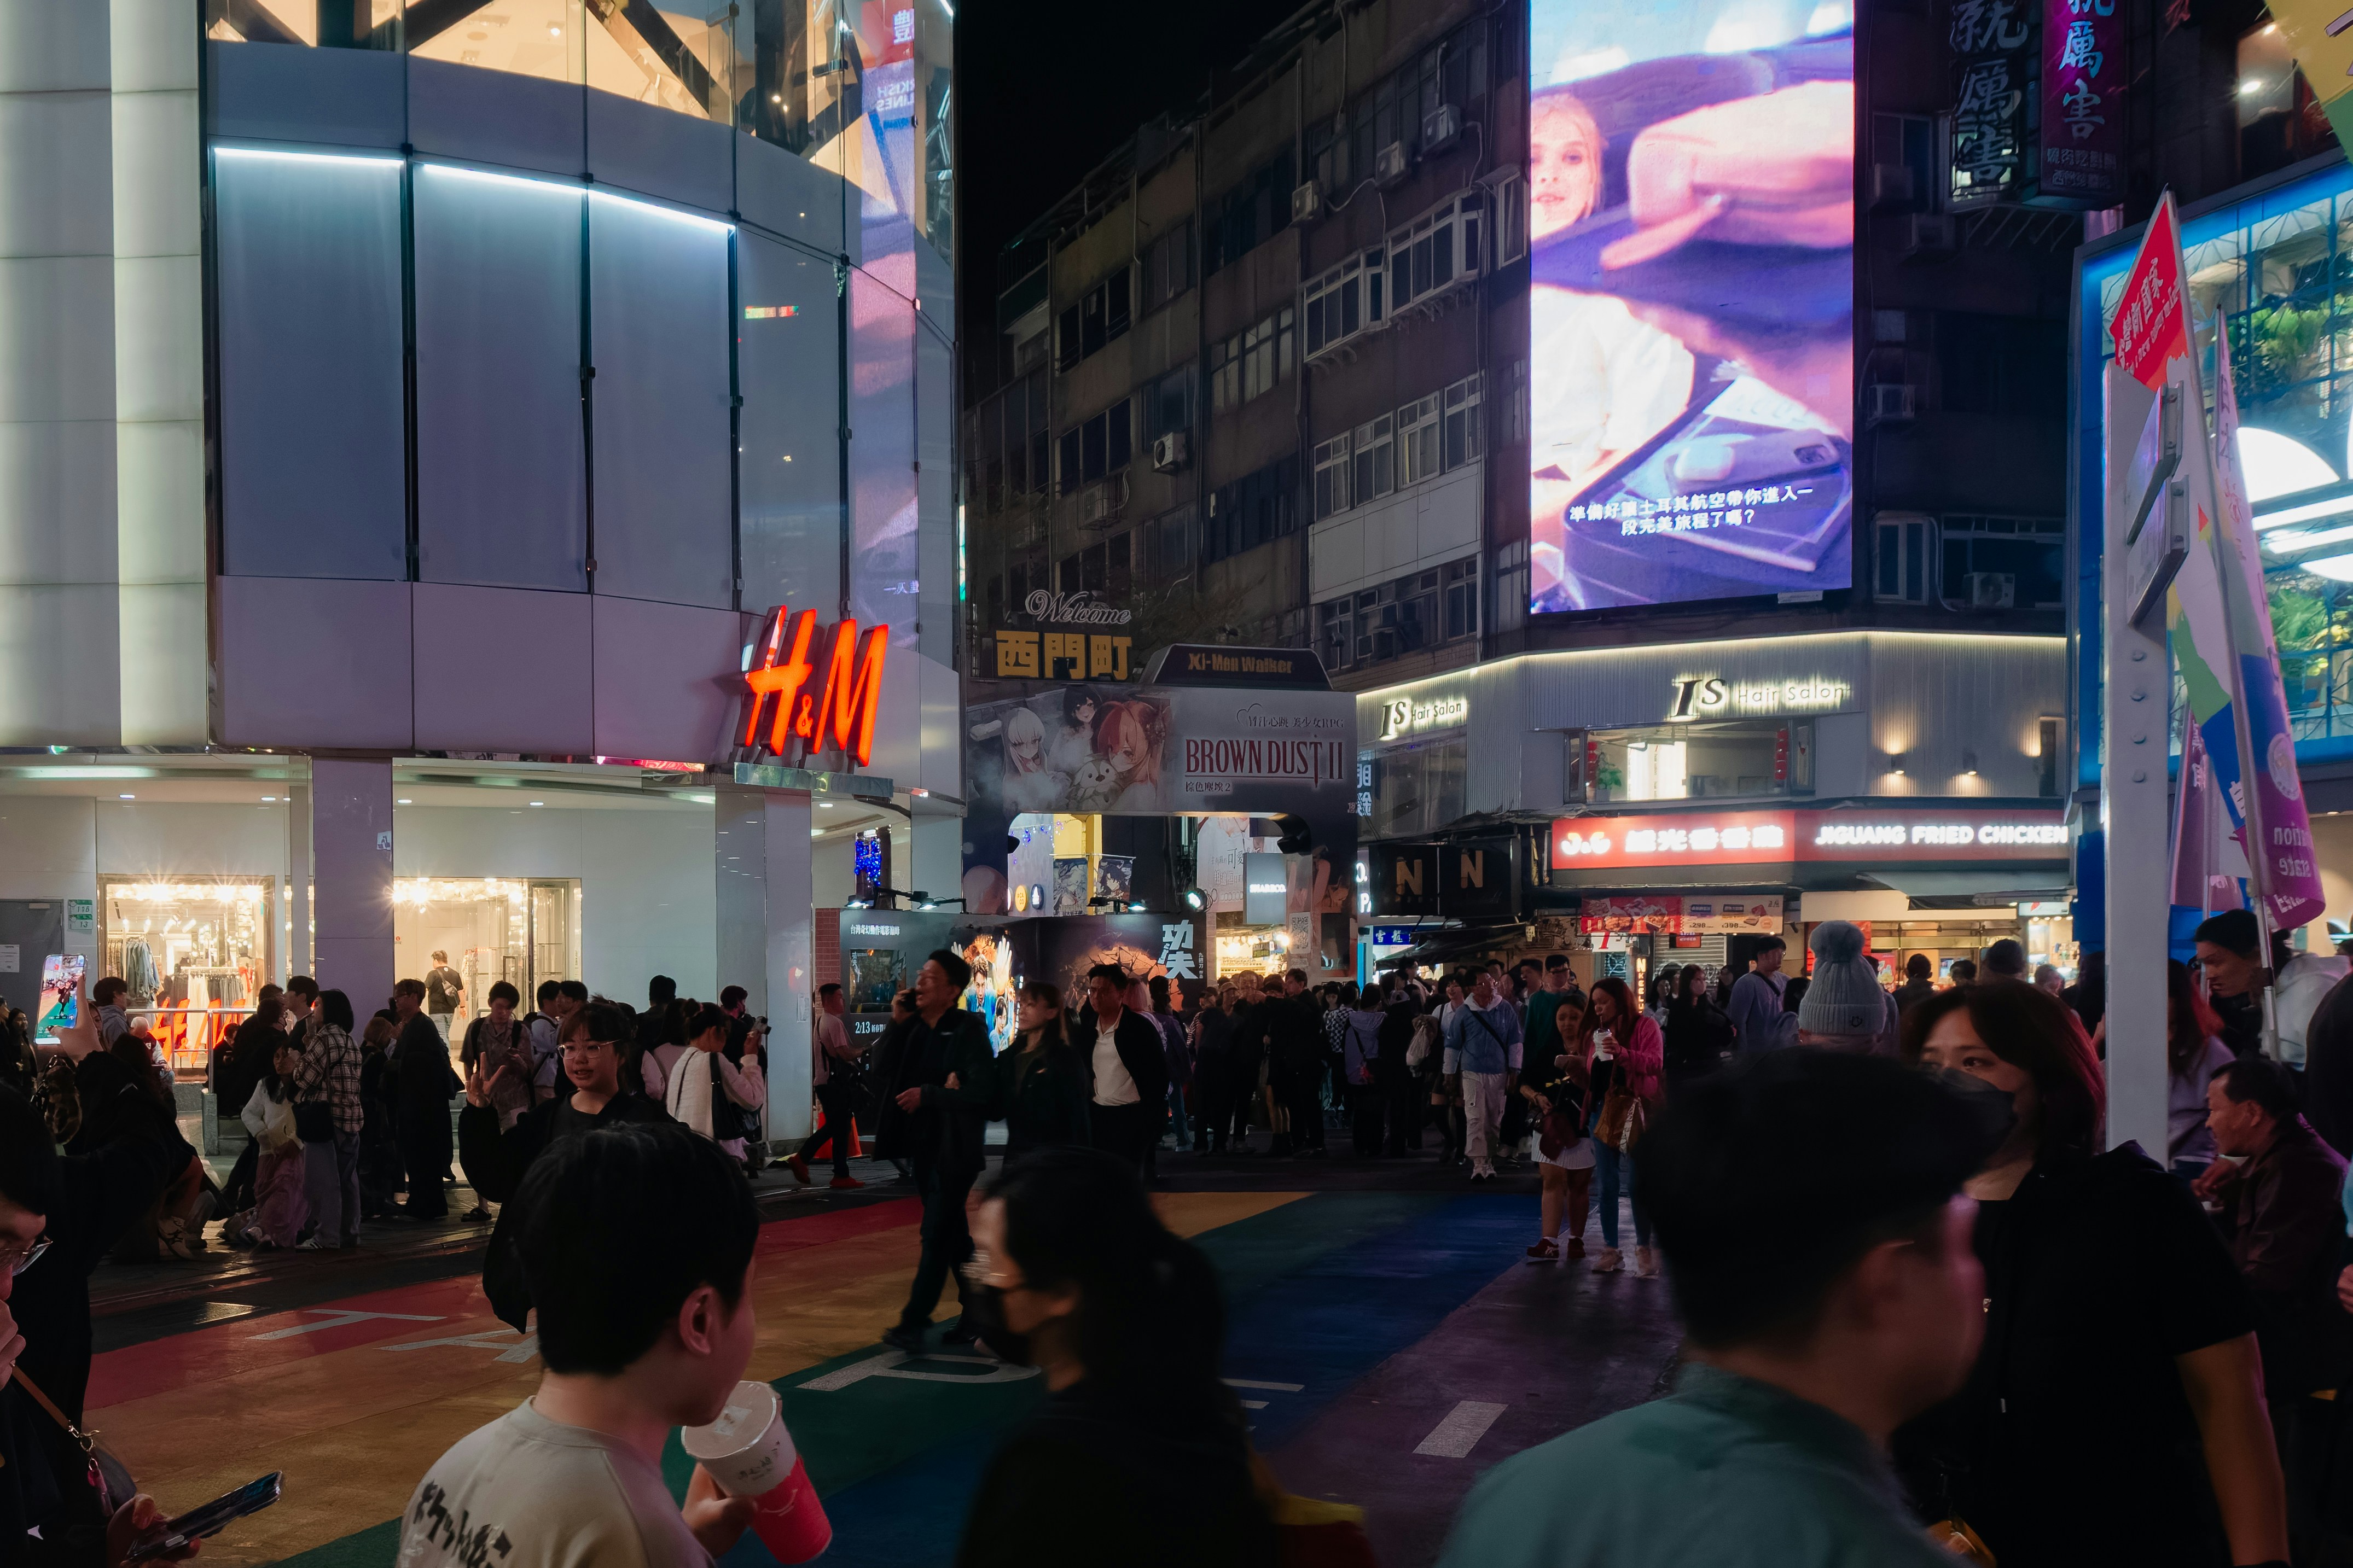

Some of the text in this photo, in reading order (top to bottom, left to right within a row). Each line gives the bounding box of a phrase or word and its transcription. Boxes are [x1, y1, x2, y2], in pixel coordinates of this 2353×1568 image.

[1025, 590, 1132, 625] Welcome
[996, 630, 1132, 680] 西門町
[1241, 656, 1292, 674] Walker
[743, 604, 889, 767] H&M
[1738, 687, 1779, 703] Hair
[1787, 683, 1846, 701] Salon
[1410, 707, 1430, 722] Hair
[1433, 702, 1463, 718] Salon
[1186, 739, 1344, 788] BROWN DUST II
[1815, 825, 2069, 846] JIGUANG FRIED CHICKEN
[1396, 857, 1422, 895] N
[1163, 919, 1199, 979] 功夫
[855, 1021, 870, 1034] 2/13
